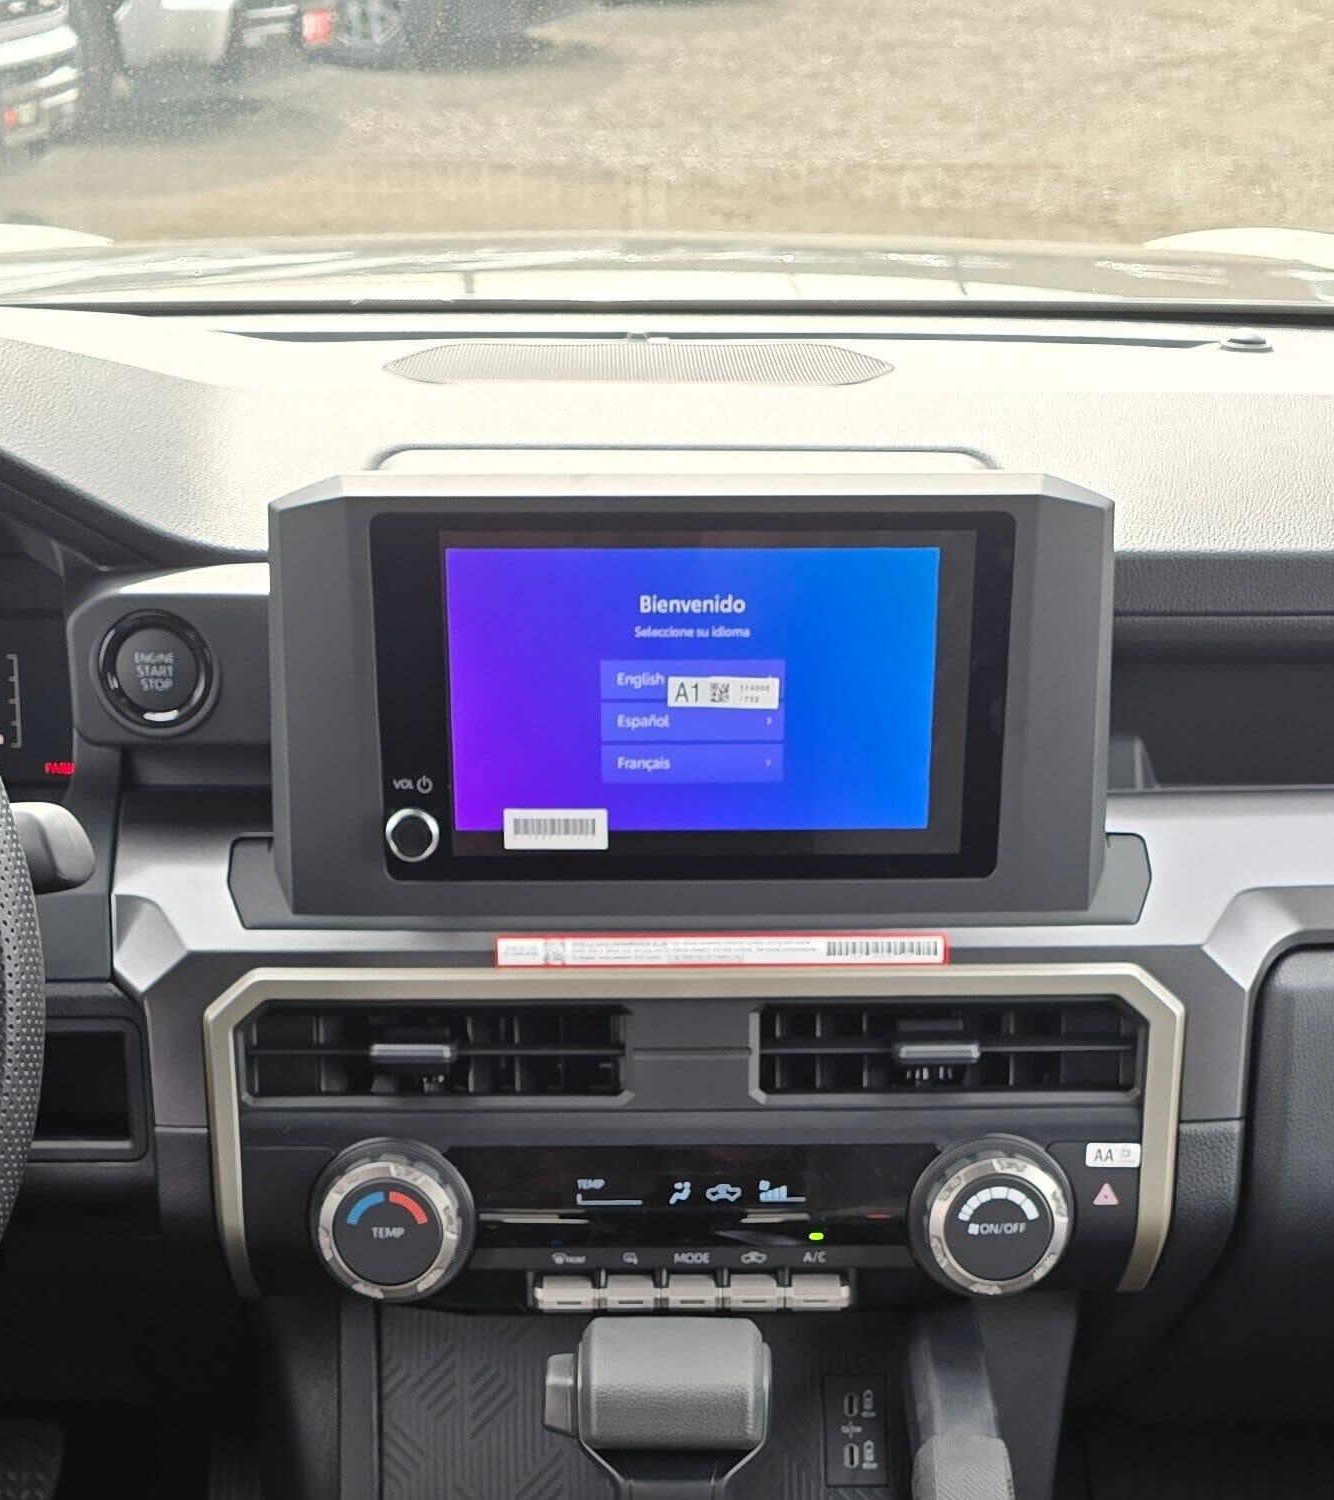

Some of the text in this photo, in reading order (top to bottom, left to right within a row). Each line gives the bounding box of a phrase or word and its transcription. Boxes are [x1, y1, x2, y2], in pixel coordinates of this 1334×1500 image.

[639, 594, 746, 613] Bienvenido
[635, 625, 750, 638] Seleccione su idioma
[134, 652, 175, 664] ENGINE
[136, 665, 173, 678] START
[140, 678, 173, 691] STOP
[617, 672, 665, 689] English
[675, 682, 699, 703] A1
[617, 714, 669, 730] Español
[617, 756, 671, 772] Français
[393, 779, 414, 790] VOL
[1094, 1149, 1114, 1162] AA
[577, 1178, 605, 1190] TEMP
[371, 1226, 405, 1239] TEMP
[979, 1222, 1027, 1234] ON/OFF
[673, 1252, 710, 1264] MODE
[802, 1251, 826, 1264] A/C
